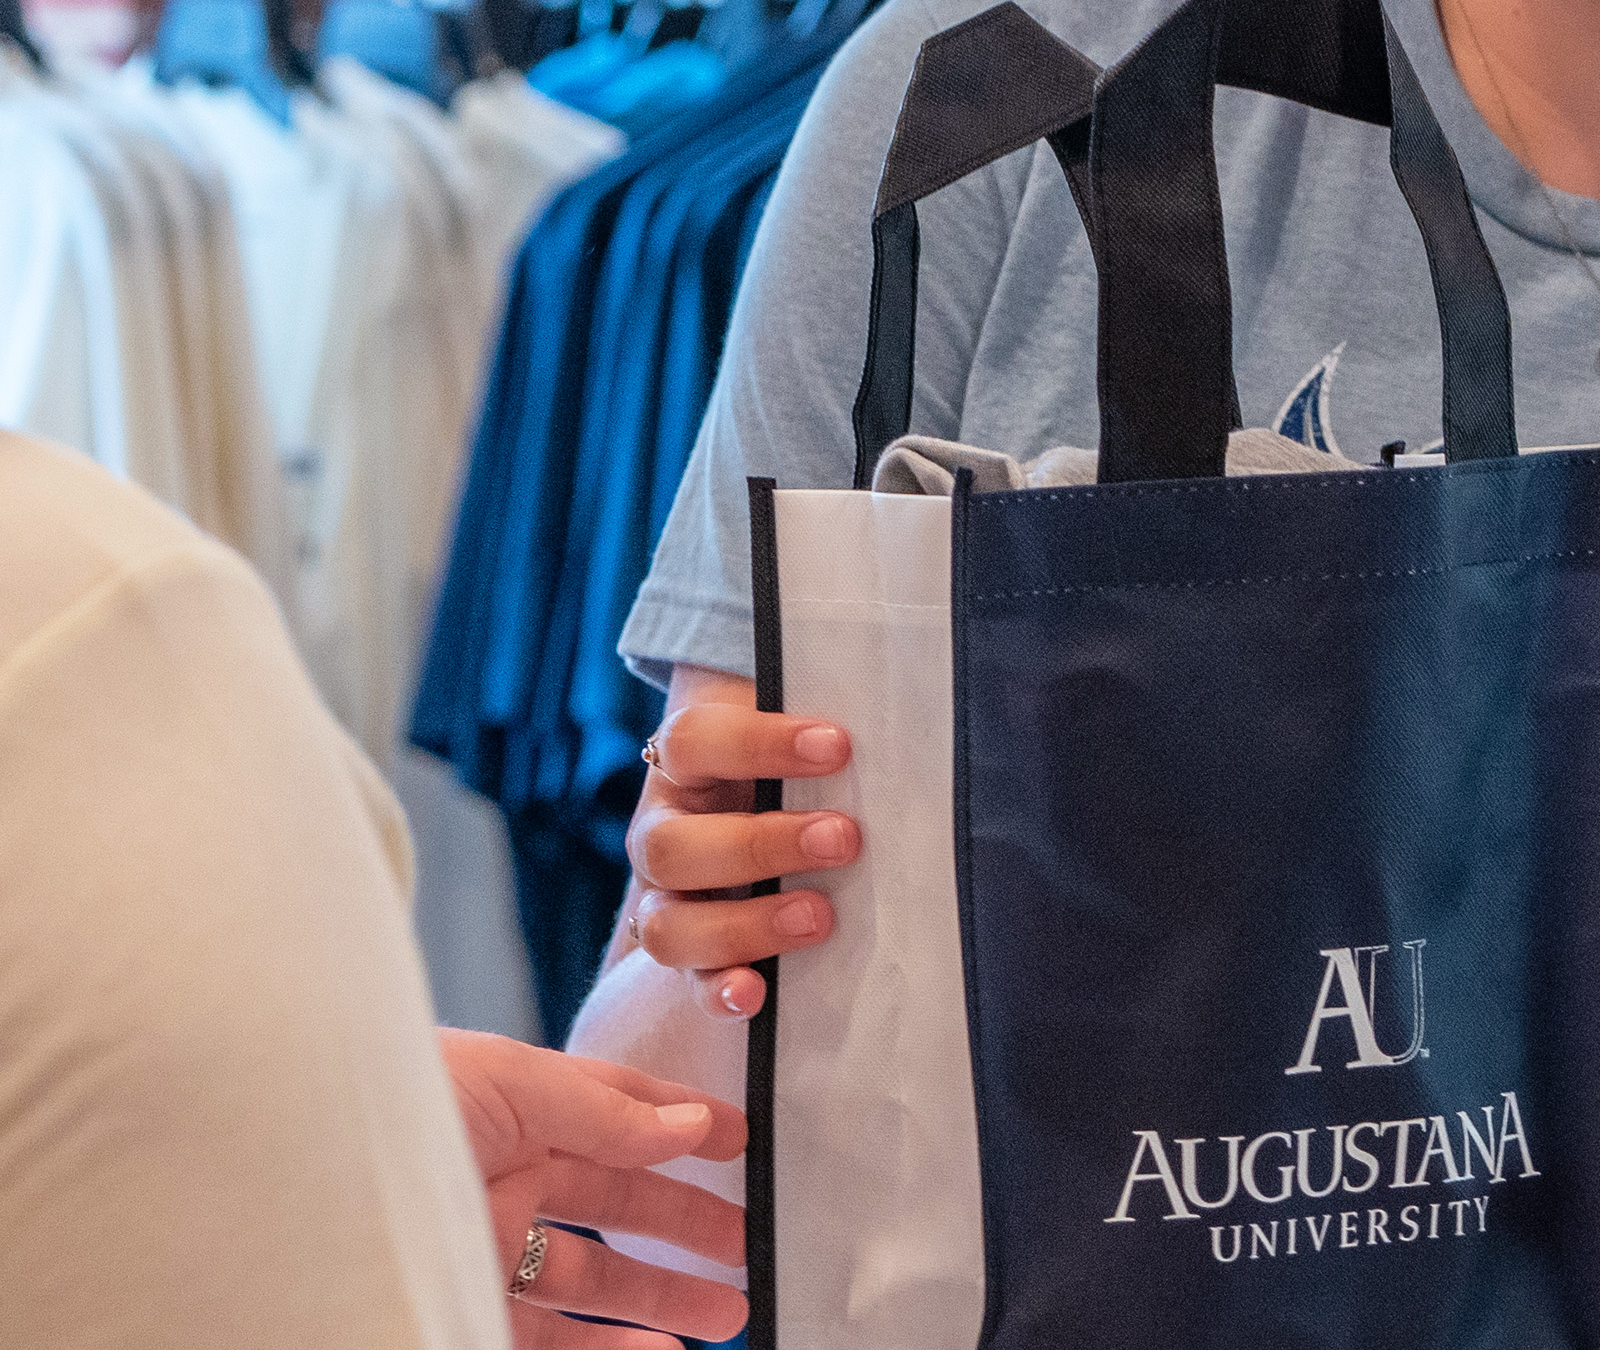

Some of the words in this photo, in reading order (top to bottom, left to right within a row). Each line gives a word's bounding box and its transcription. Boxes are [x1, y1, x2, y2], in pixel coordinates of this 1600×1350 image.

[1285, 938, 1429, 1075] AU
[1104, 1092, 1541, 1223] AUGUSTANA
[1210, 1196, 1490, 1262] UNIVERSITY
